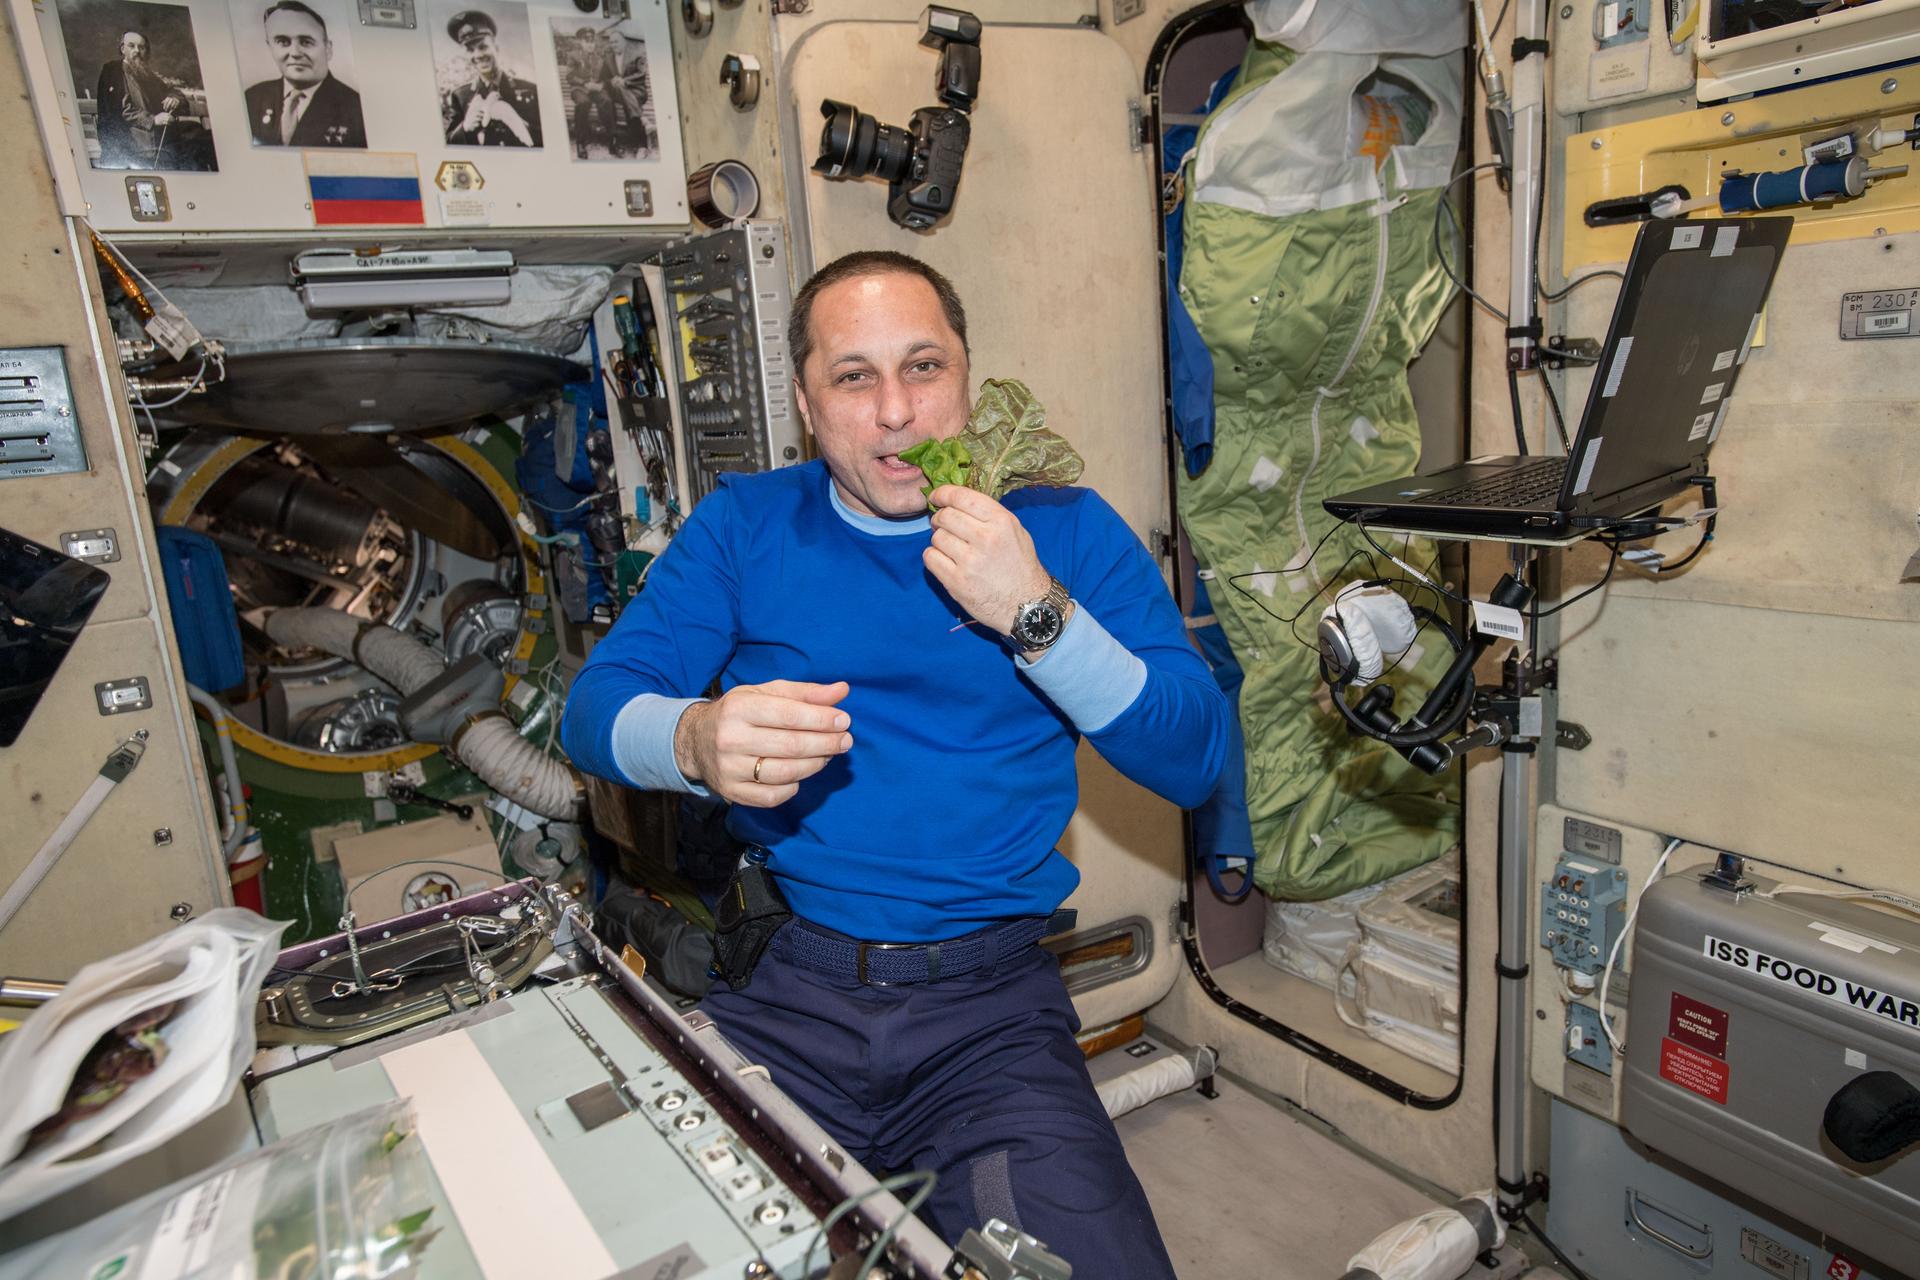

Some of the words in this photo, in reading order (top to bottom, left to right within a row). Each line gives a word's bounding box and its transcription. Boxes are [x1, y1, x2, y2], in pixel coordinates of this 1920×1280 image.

[1872, 293, 1906, 309] 230
[1709, 938, 1750, 968] ISS
[1756, 954, 1838, 996] FOOD
[1845, 982, 1920, 1027] WAR
[1684, 1009, 1712, 1025] CAUTION
[1679, 1021, 1696, 1033] BEFORE
[1696, 1028, 1716, 1041] OPENING
[1666, 1052, 1686, 1065] ПЕРЕД
[1686, 1058, 1722, 1080] ОТКРЫТИЕМ
[1666, 1064, 1721, 1093] ЭЛЕКТРОПИТАНИЕ
[1674, 1074, 1712, 1095] ОТКЛЮЧЕНО
[1830, 1258, 1853, 1280] 3
